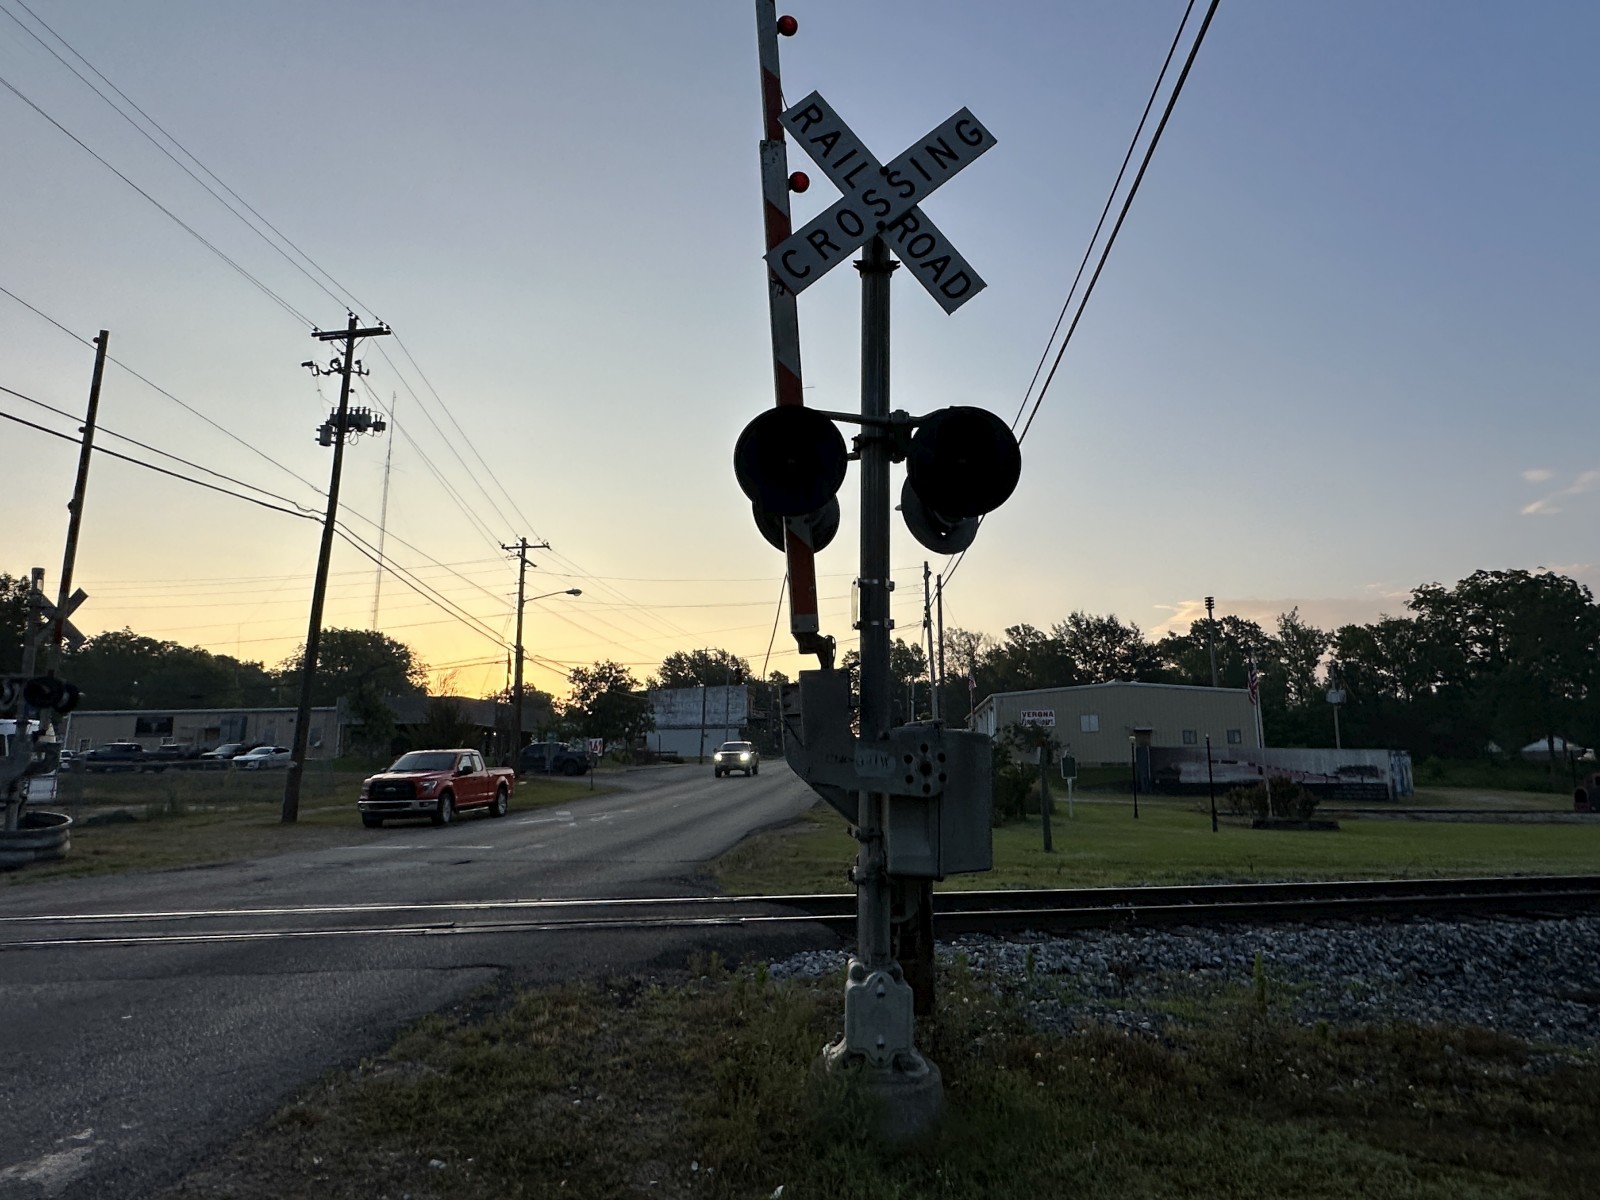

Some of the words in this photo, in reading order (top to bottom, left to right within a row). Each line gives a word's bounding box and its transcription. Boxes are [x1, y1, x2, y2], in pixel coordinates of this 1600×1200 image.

[781, 119, 983, 279] CROSSING
[791, 103, 868, 189] RAIL
[887, 212, 972, 299] ROAD
